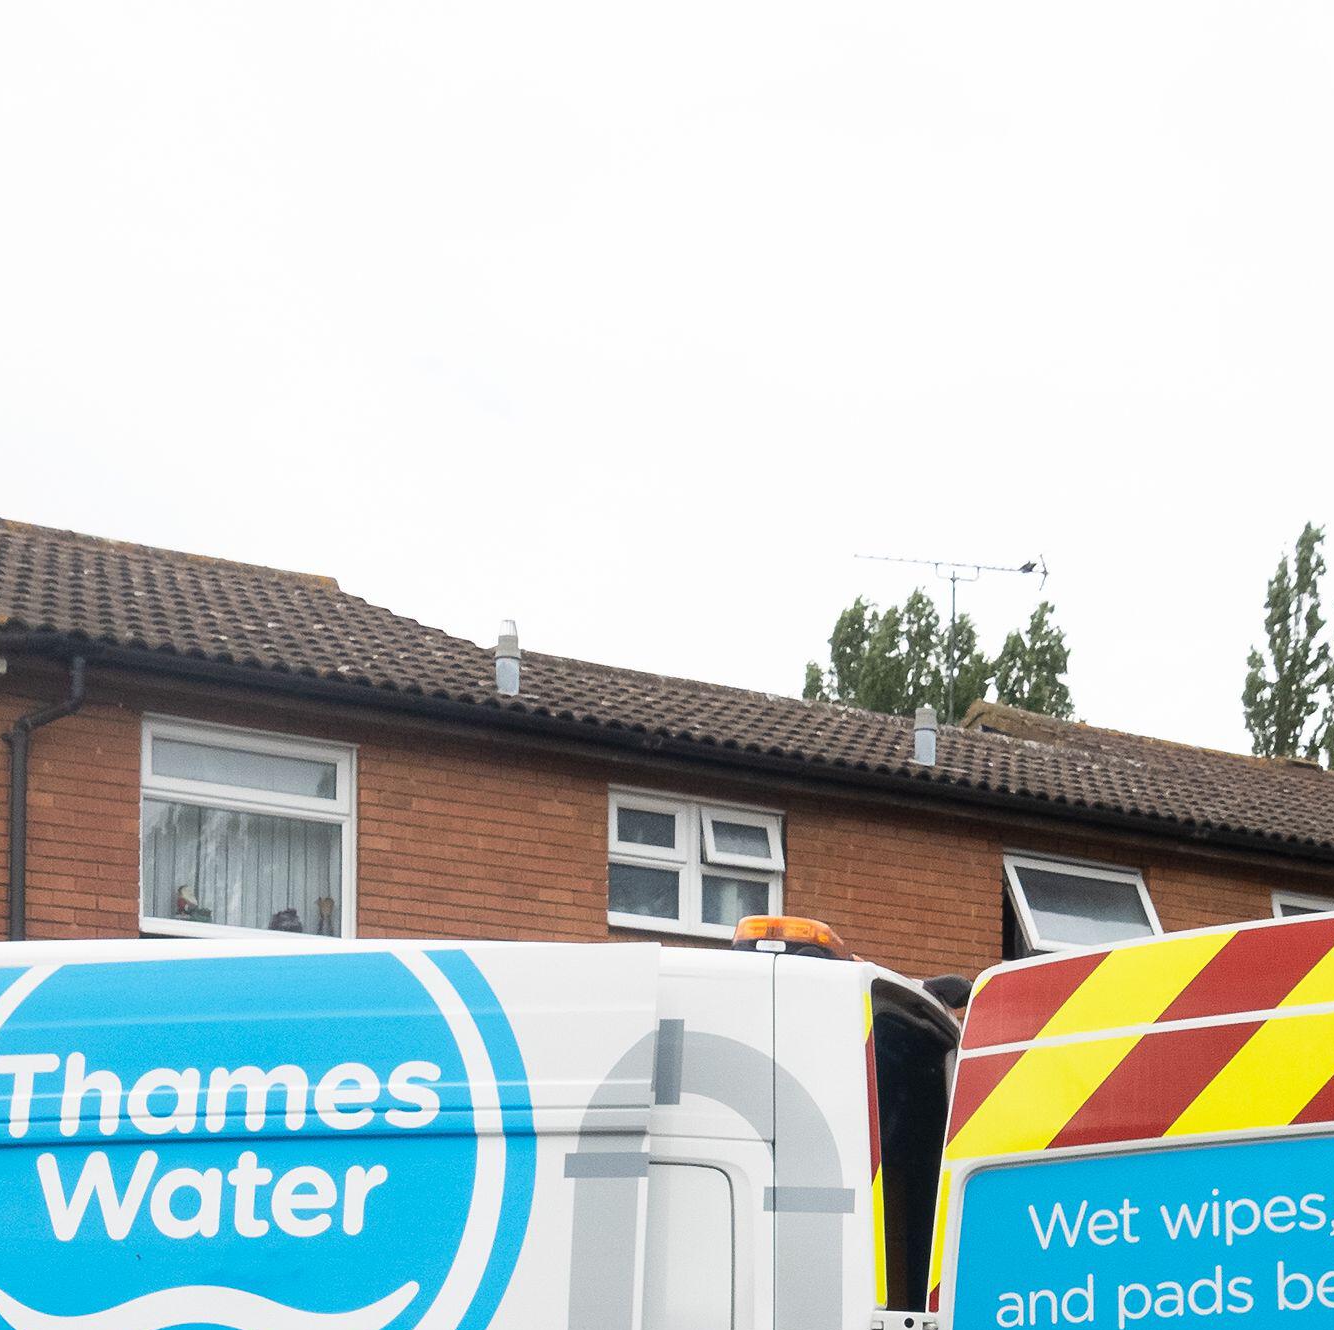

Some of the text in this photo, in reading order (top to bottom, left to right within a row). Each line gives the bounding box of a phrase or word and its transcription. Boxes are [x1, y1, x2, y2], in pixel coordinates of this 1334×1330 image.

[37, 1150, 388, 1242] Water
[1028, 1199, 1140, 1250] Wet
[996, 1274, 1094, 1327] and
[1117, 1265, 1254, 1330] pads
